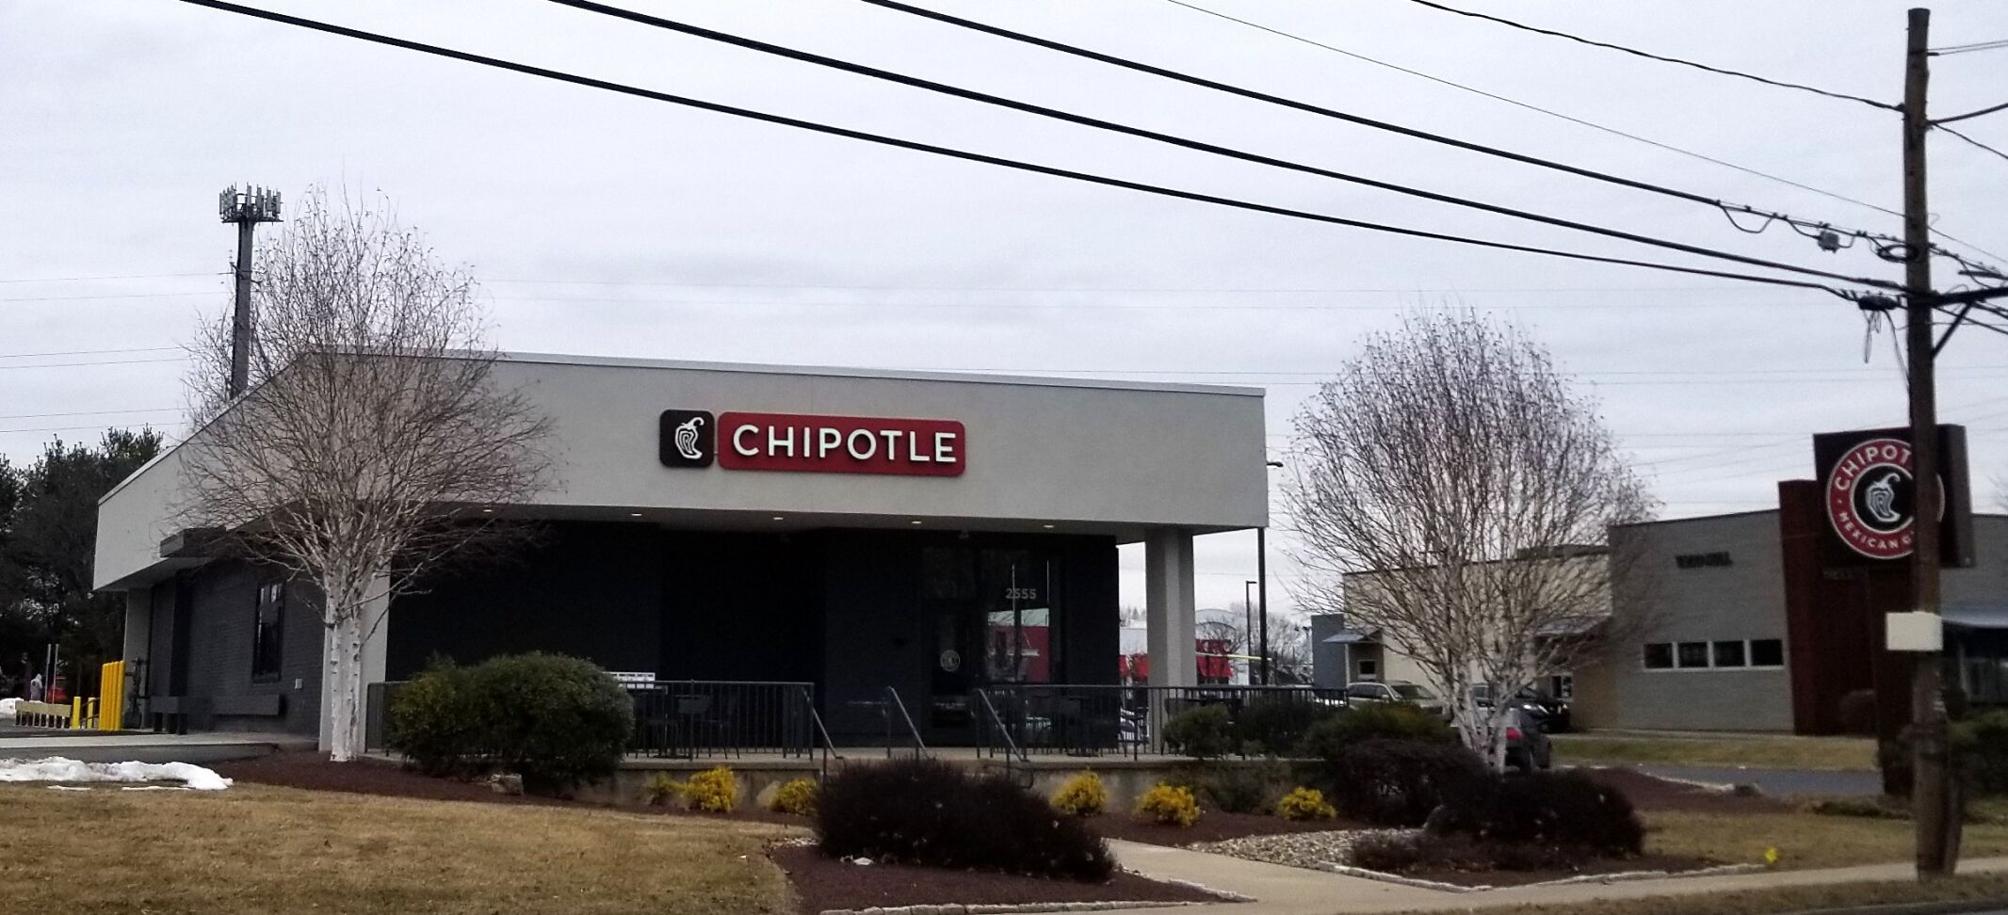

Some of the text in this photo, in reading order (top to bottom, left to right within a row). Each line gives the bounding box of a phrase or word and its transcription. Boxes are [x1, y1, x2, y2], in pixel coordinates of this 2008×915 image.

[733, 424, 957, 462] CHIPOTLE
[1834, 445, 1912, 490] CHIPOT
[1839, 511, 1899, 549] MEXICAN
[1005, 587, 1037, 599] 2555
